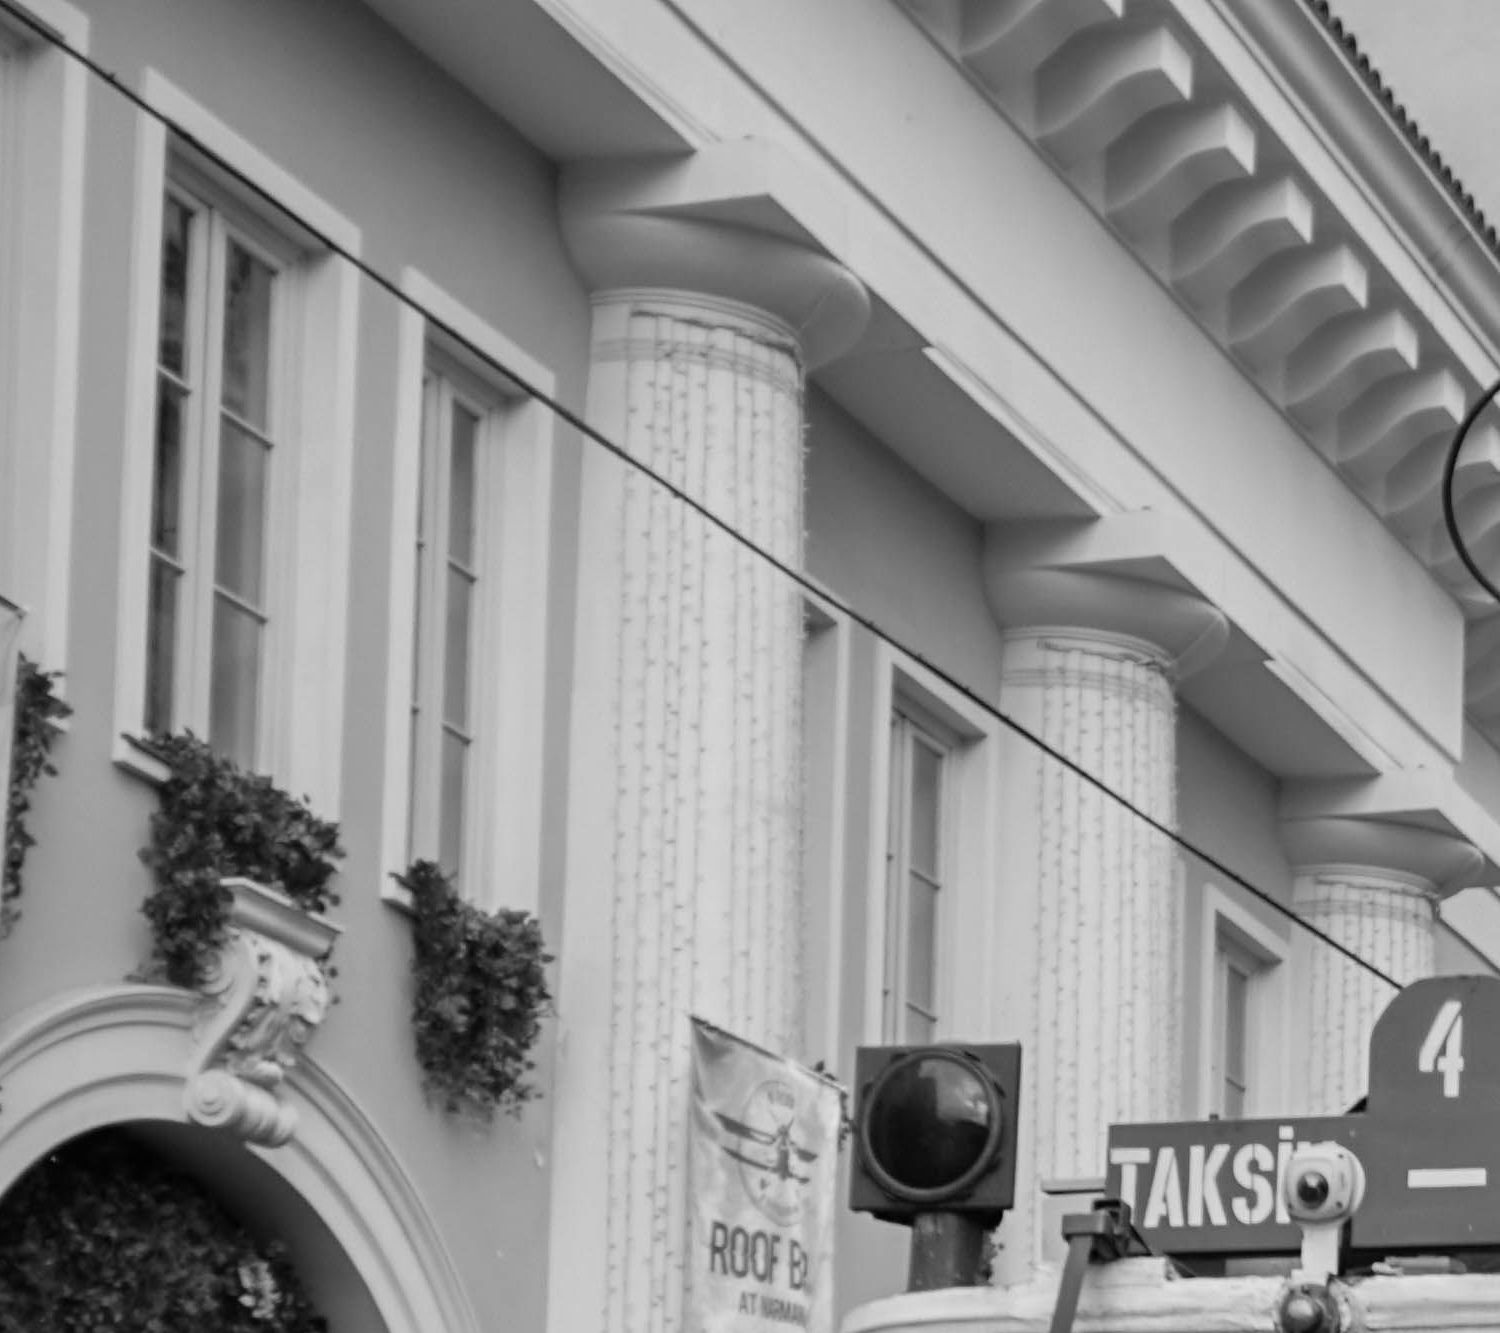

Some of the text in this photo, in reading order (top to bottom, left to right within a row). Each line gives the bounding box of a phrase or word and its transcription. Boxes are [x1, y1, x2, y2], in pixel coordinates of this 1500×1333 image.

[1417, 998, 1465, 1099] 4
[1109, 1125, 1308, 1229] TAKSİ
[709, 1220, 781, 1285] ROOF
[738, 1290, 758, 1316] AT
